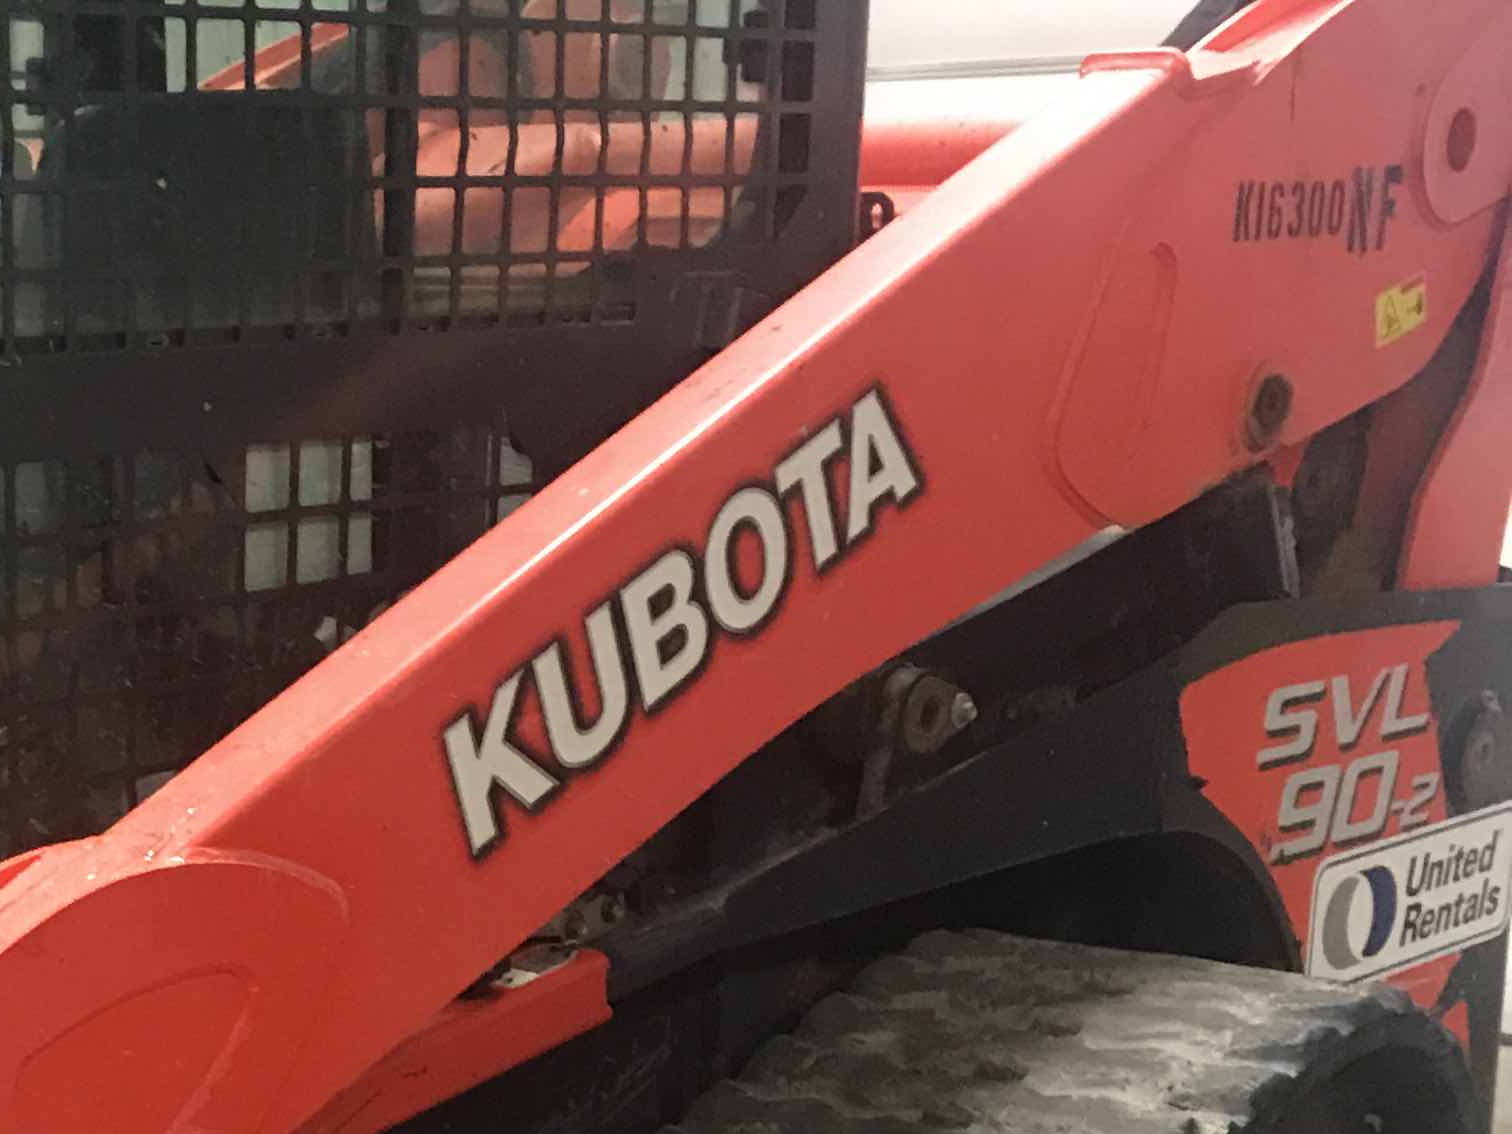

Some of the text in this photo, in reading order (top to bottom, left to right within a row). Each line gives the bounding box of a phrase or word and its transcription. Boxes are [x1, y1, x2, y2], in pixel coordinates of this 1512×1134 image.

[441, 385, 924, 860] KUBOTA
[1256, 663, 1431, 771] SVL
[1405, 829, 1502, 897] United
[1398, 884, 1501, 946] Rentals
